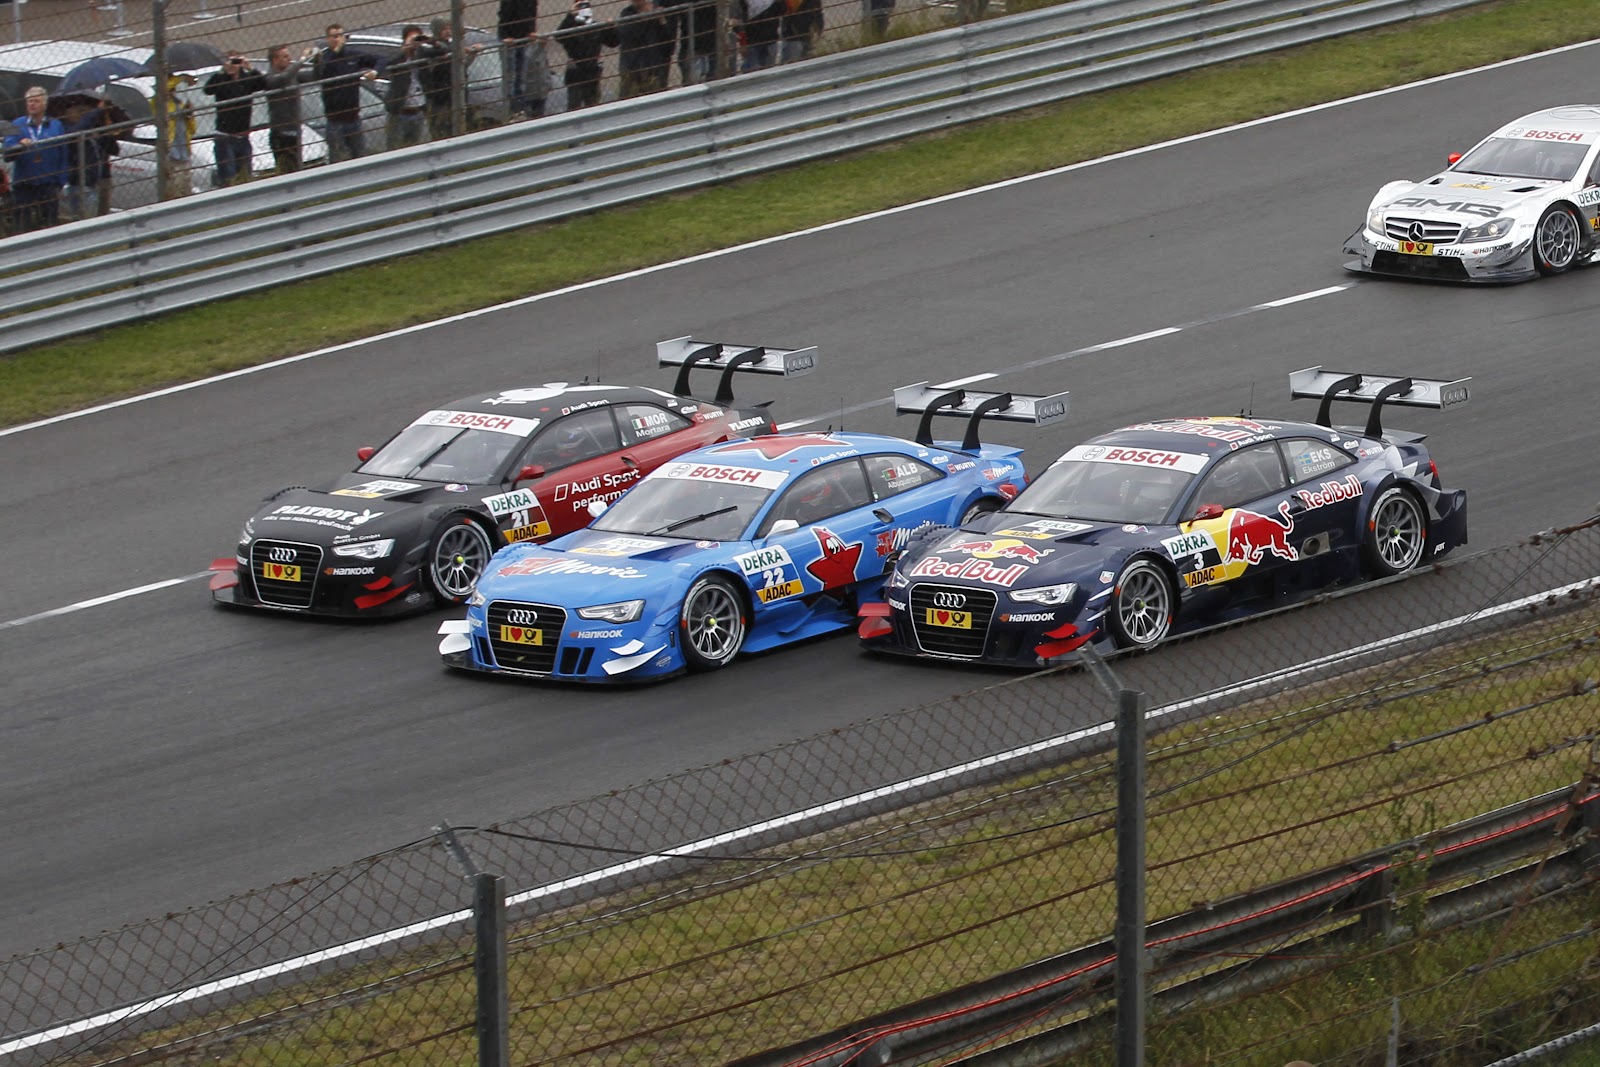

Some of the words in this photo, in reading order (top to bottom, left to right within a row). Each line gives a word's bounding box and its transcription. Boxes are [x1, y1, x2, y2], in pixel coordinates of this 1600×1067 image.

[1524, 130, 1584, 142] BOSCH
[1383, 197, 1504, 218] AMG
[1374, 240, 1396, 251] STIHL
[1437, 248, 1465, 257] STIHL
[449, 413, 515, 430] BOSCH
[644, 413, 668, 427] MOR
[728, 416, 765, 431] PLAYBOY
[635, 424, 671, 438] Mortara
[1104, 449, 1181, 467] BOSCH
[1310, 448, 1332, 463] EKS
[689, 466, 762, 484] BOSCH
[897, 462, 919, 478] ALB
[1302, 460, 1336, 474] Ekström
[571, 476, 601, 495] Audi
[603, 468, 641, 487] Sport
[1297, 483, 1335, 511] Red
[1331, 474, 1363, 504] Bull
[490, 493, 532, 512] DEKRA
[272, 505, 358, 521] PLAYBOY
[511, 509, 530, 528] 21
[513, 524, 538, 542] ADAC
[1035, 520, 1079, 530] DEKRA
[1170, 534, 1208, 555] DEKRA
[743, 549, 784, 571] DEKRA
[1194, 552, 1204, 570] 3
[763, 567, 785, 588] 22
[909, 557, 969, 579] Red
[963, 558, 1029, 587] Bull
[1191, 568, 1215, 587] ADAC
[766, 583, 791, 602] ADAC
